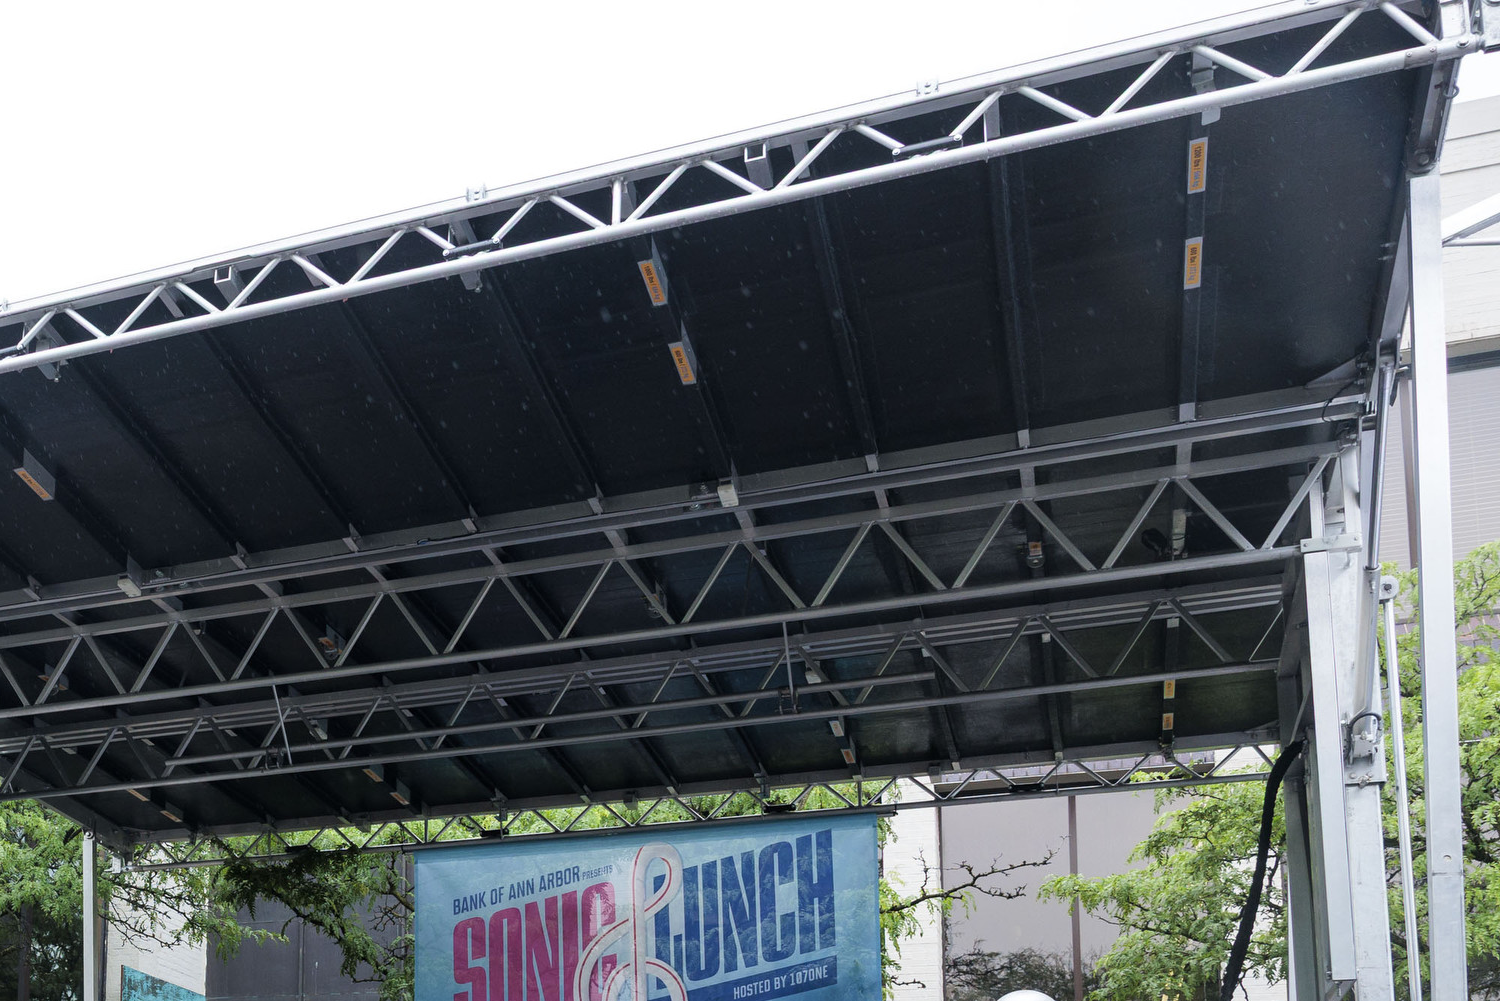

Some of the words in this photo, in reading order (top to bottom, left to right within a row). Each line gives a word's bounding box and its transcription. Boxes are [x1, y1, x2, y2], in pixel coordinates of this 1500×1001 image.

[453, 891, 487, 915] BANK
[490, 886, 505, 906] OF
[509, 878, 535, 901] ANN
[539, 865, 580, 892] ARBOR
[582, 865, 613, 881] PRESENTS
[653, 828, 837, 991] LUNCH
[733, 979, 770, 1000] HOSTED
[774, 975, 787, 990] BY
[790, 965, 828, 986] 107ONE
